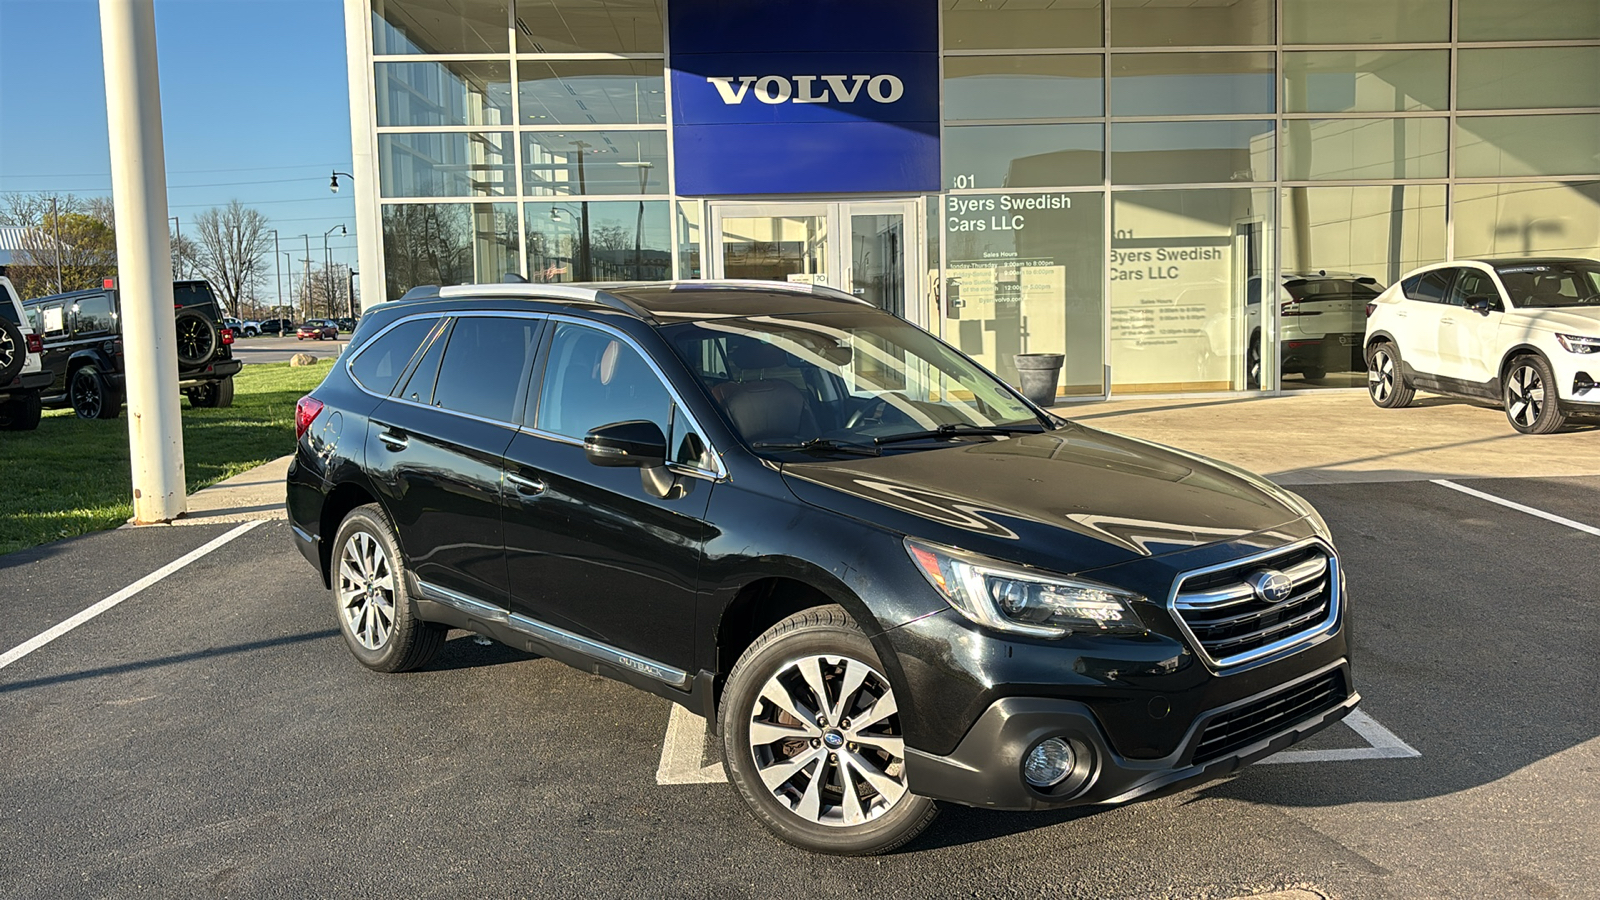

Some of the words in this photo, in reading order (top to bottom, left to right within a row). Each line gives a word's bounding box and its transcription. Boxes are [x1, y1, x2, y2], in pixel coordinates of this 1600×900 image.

[706, 74, 904, 105] VOLVO
[953, 174, 975, 189] 01
[949, 197, 995, 215] Byers
[1000, 194, 1071, 210] Swedish
[949, 217, 986, 232] Cars
[991, 215, 1025, 230] LLC
[1156, 247, 1222, 261] Swedish
[1110, 267, 1144, 281] Cars
[1148, 266, 1179, 279] LLC
[619, 656, 663, 677] OUTBACK
